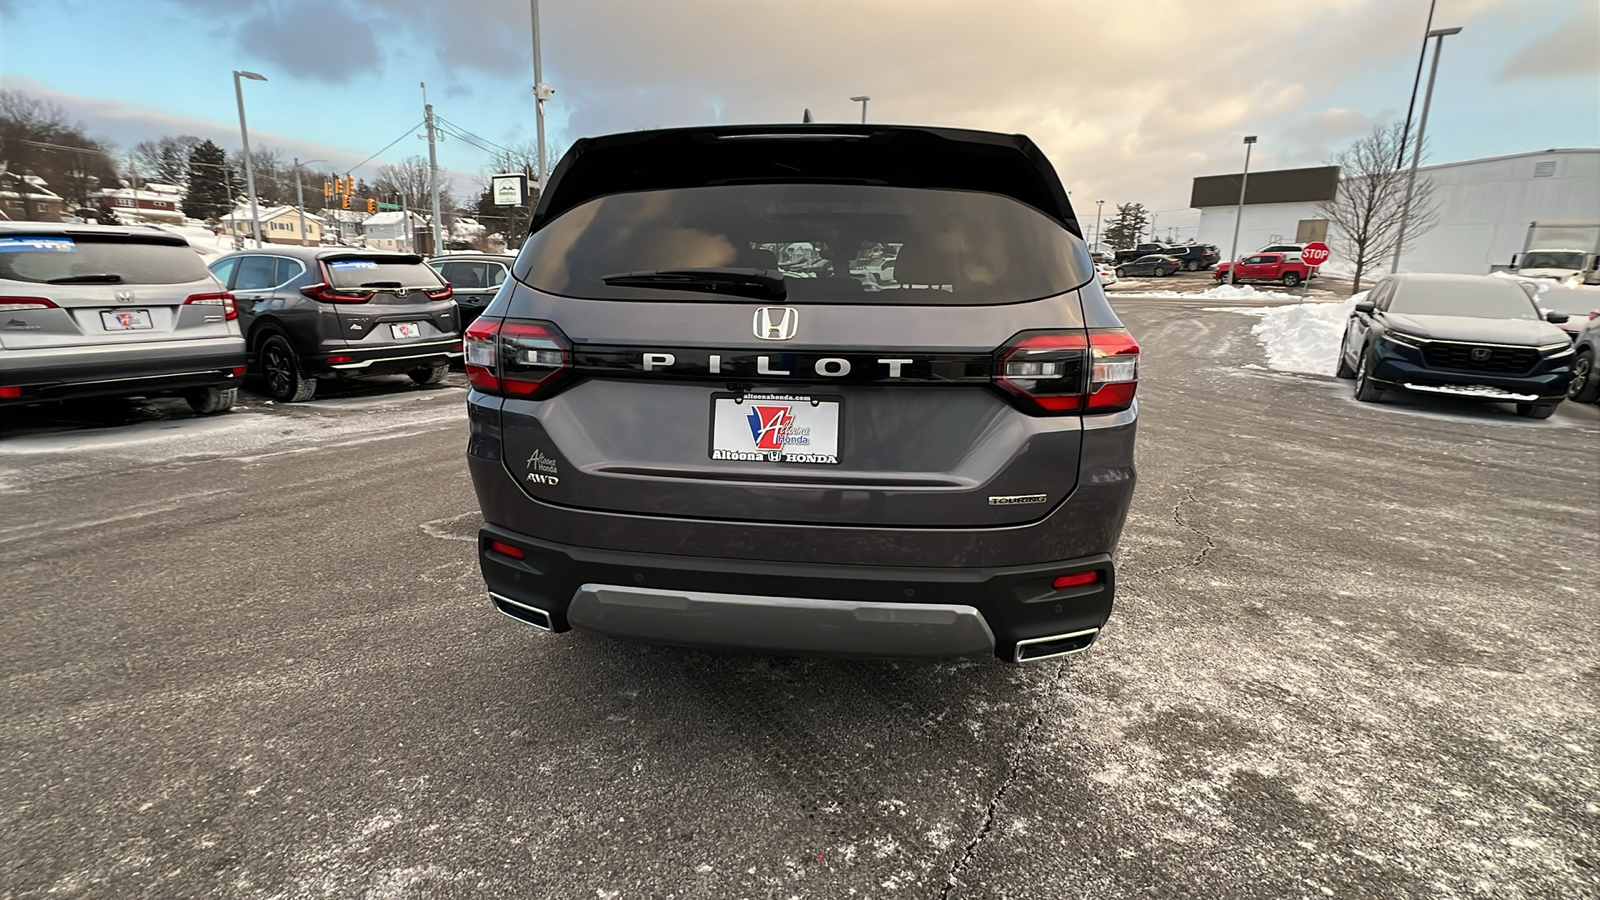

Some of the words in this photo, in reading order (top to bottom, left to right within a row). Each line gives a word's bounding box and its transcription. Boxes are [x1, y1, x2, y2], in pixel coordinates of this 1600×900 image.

[1302, 248, 1329, 259] STOP
[643, 353, 913, 378] PILOT
[743, 393, 811, 401] altoonahonda.com
[777, 434, 809, 444] Honda
[712, 450, 764, 461] Altoona
[785, 454, 838, 464] HONDA
[526, 472, 559, 486] AWD
[990, 496, 1046, 505] TOURING
